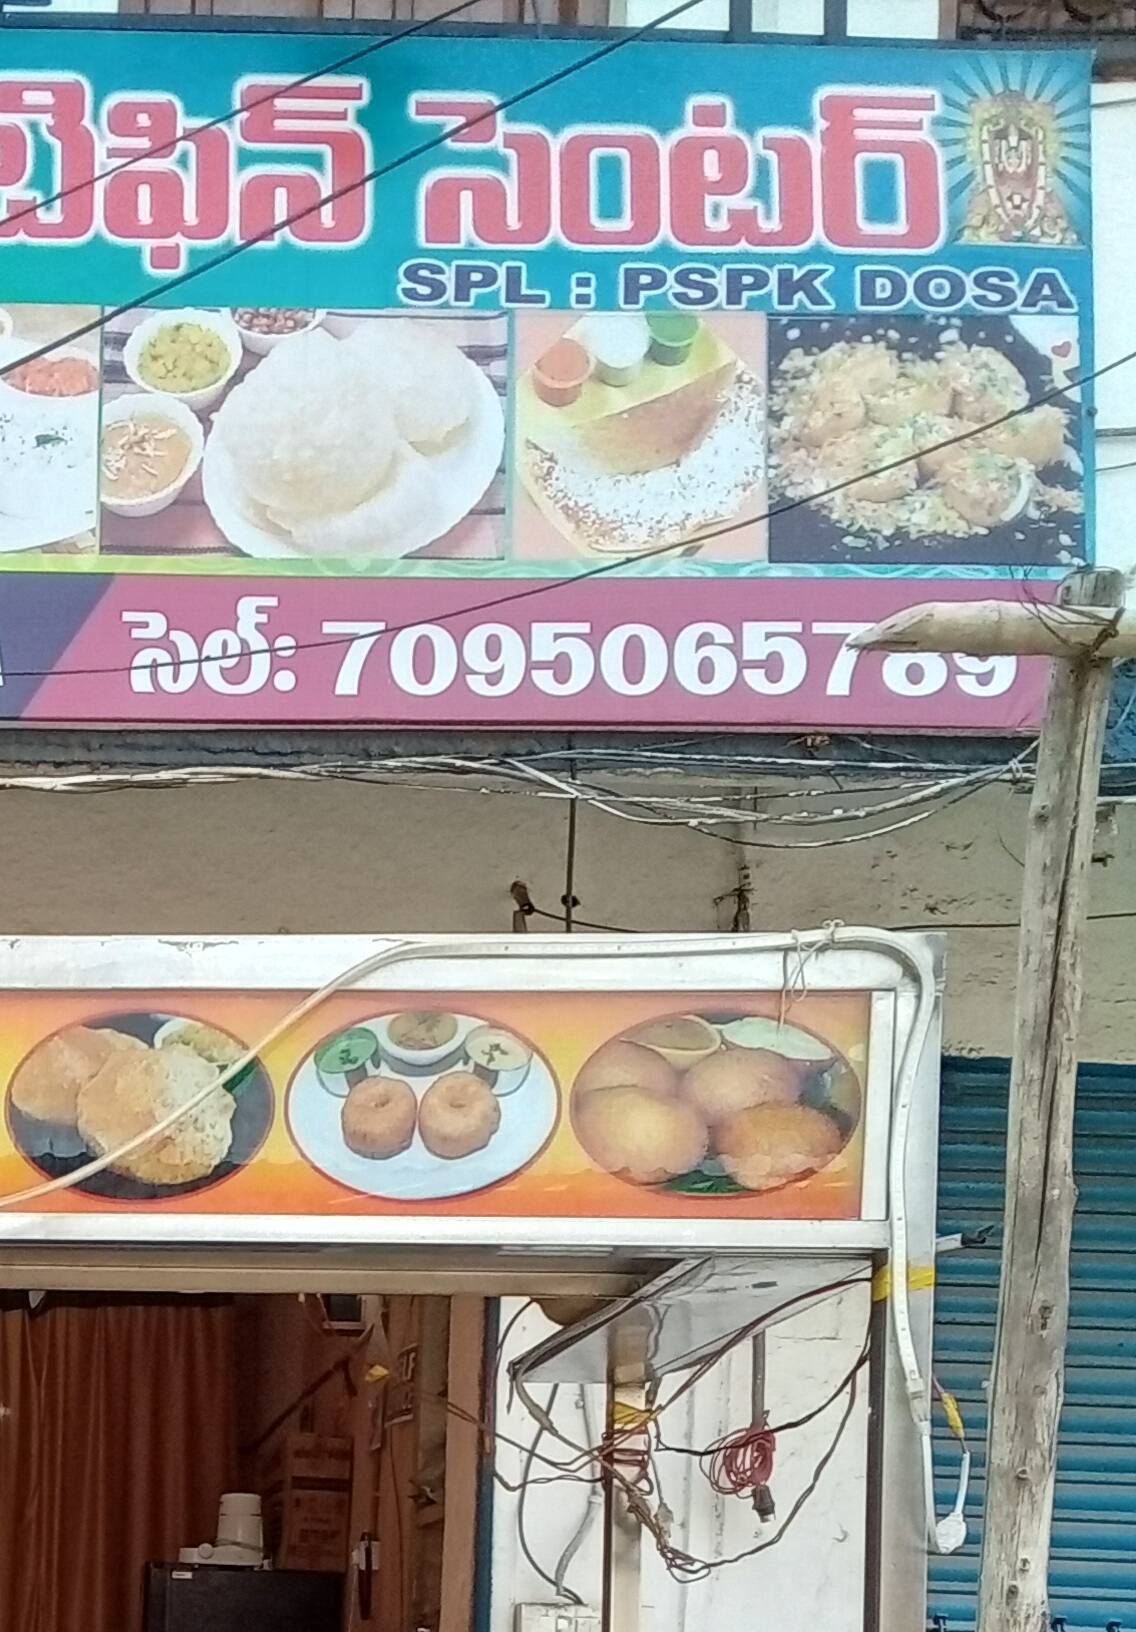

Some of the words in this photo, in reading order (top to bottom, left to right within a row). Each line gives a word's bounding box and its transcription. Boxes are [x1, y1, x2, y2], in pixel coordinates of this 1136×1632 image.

[415, 92, 943, 248] సెంటర్
[402, 266, 547, 304] SPL
[622, 268, 834, 309] PSPK
[857, 268, 1077, 309] DOSA
[322, 620, 1018, 697] 7095065789
